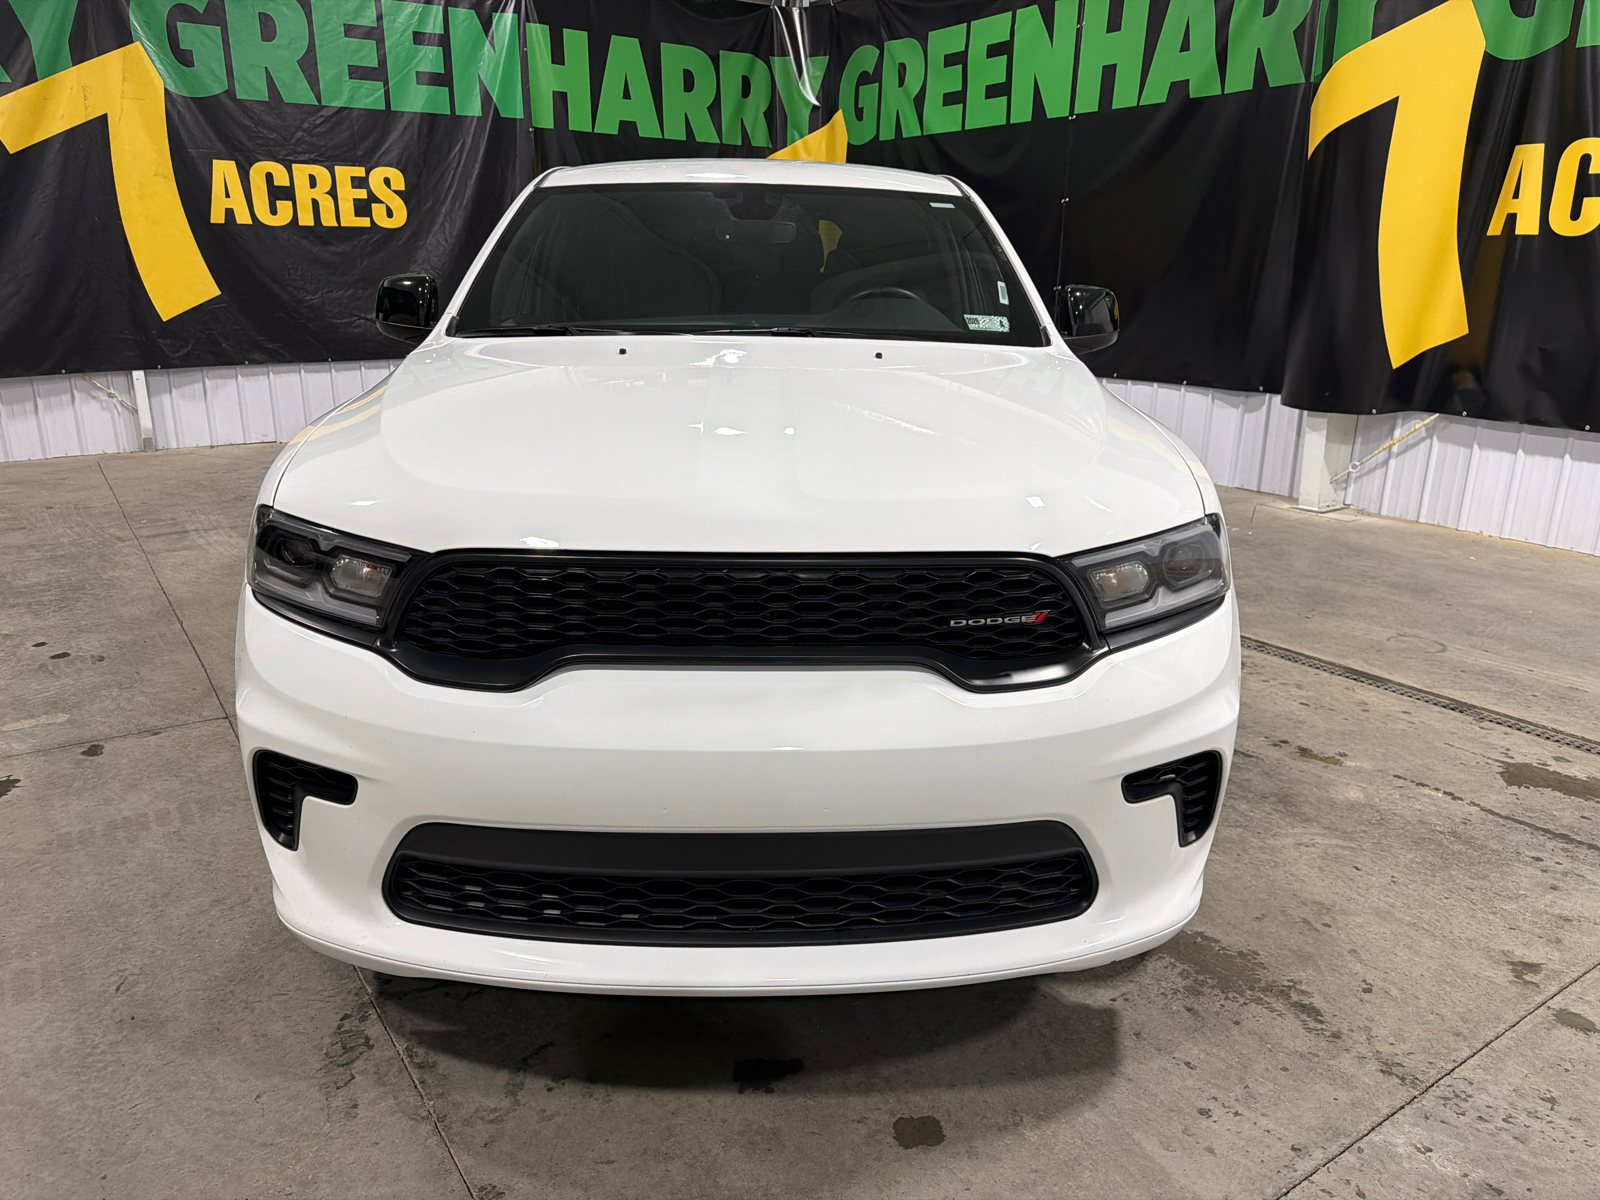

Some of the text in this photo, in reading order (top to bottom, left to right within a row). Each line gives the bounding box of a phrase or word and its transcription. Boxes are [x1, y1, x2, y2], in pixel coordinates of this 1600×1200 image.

[129, 0, 525, 119] GREEN
[526, 22, 830, 148] HARRY
[839, 2, 1081, 146] GREEN
[1074, 0, 1378, 115] HAR
[0, 41, 222, 322] 7
[210, 159, 408, 229] ACRES
[1307, 0, 1487, 370] 7
[949, 614, 1037, 627] DODGE
